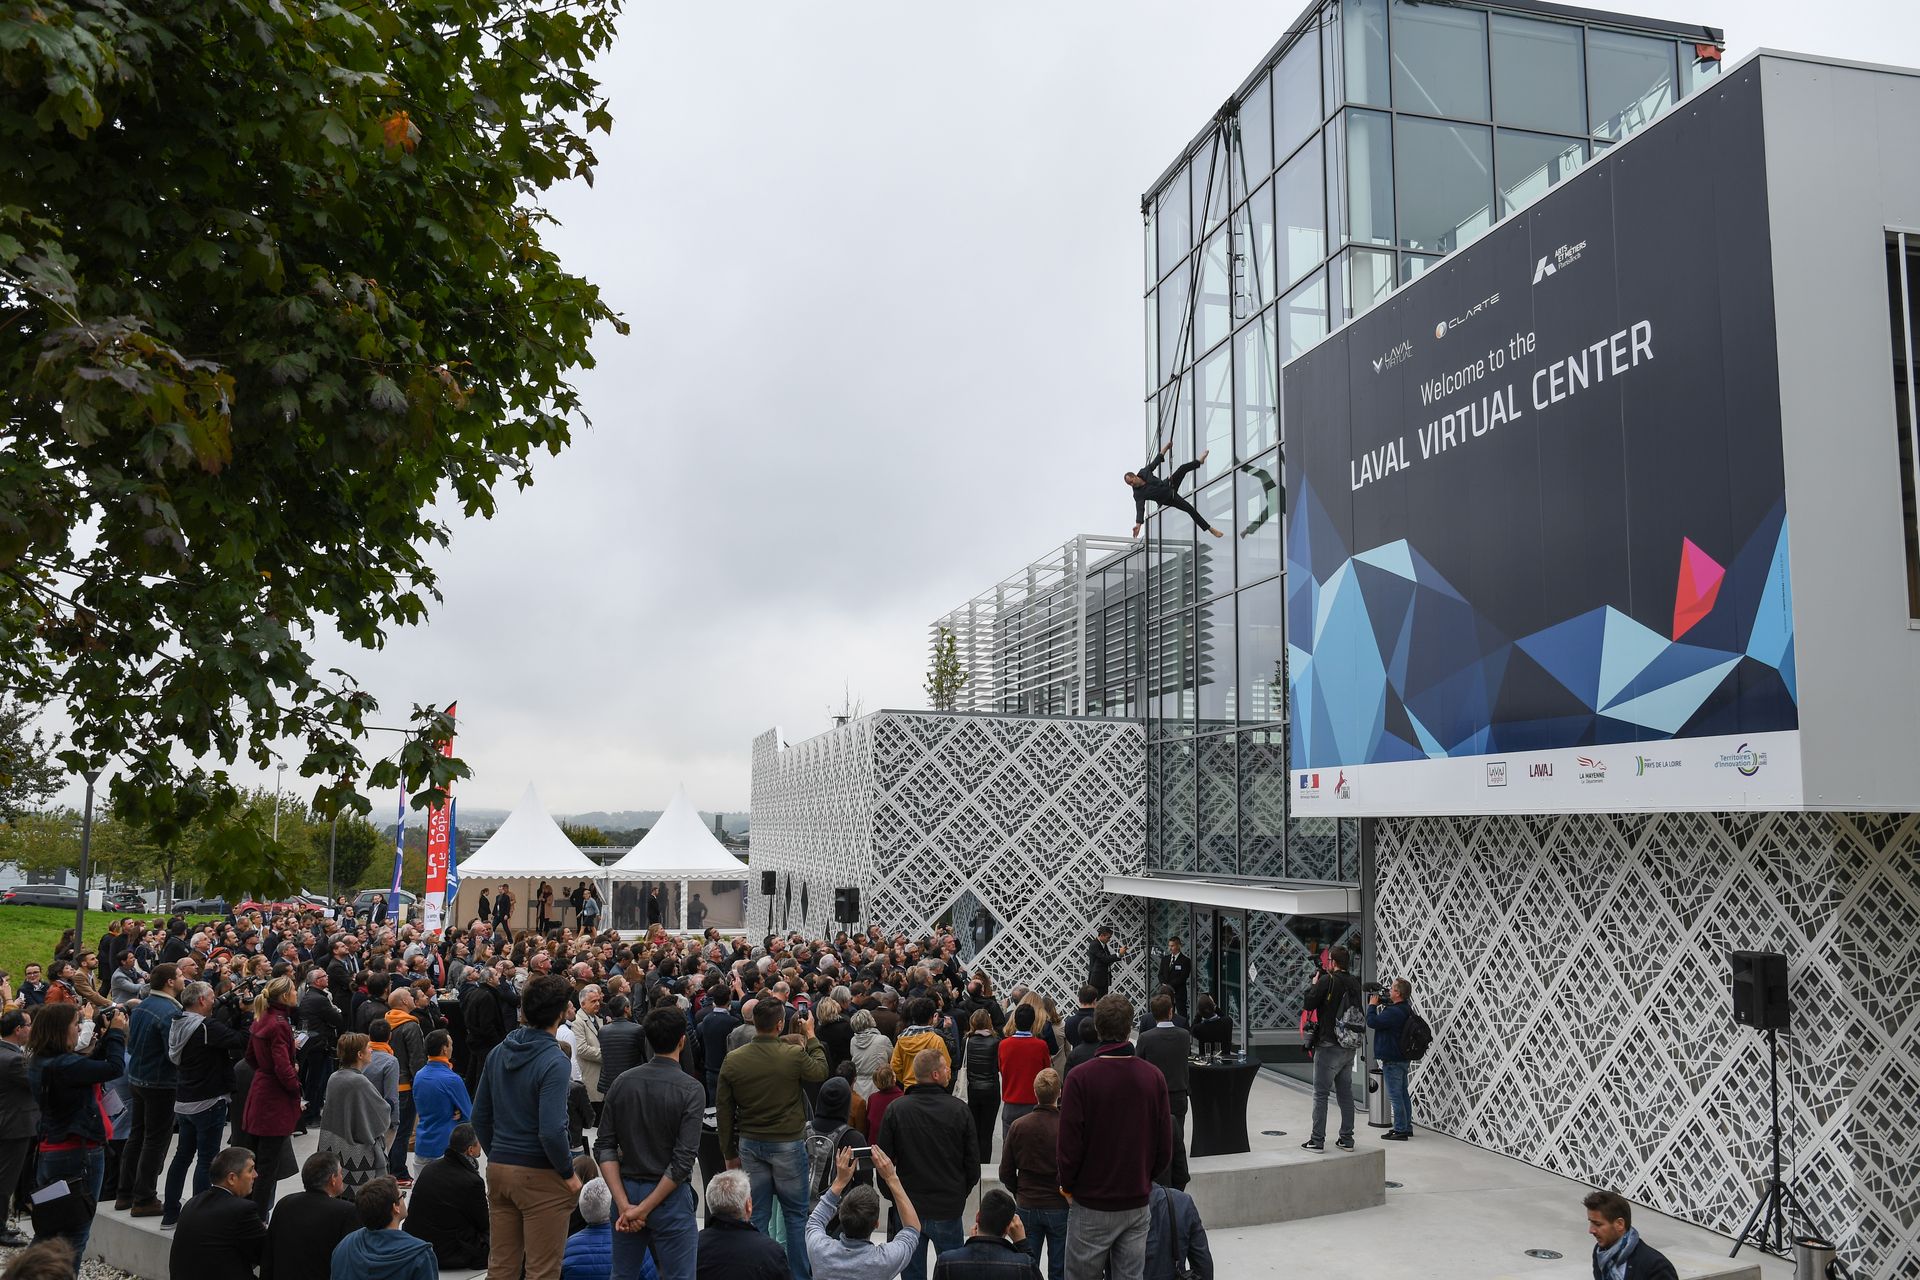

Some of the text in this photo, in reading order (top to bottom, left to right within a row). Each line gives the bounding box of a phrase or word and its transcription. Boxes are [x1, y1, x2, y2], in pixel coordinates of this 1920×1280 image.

[1554, 244, 1568, 258] ARTS
[1557, 253, 1564, 263] ET
[1384, 339, 1413, 363] LAVAL
[1420, 332, 1536, 407] Welcome to the
[1350, 319, 1654, 492] LAVAL VIRTUAL CENTER
[1585, 771, 1605, 779] MAYENNE
